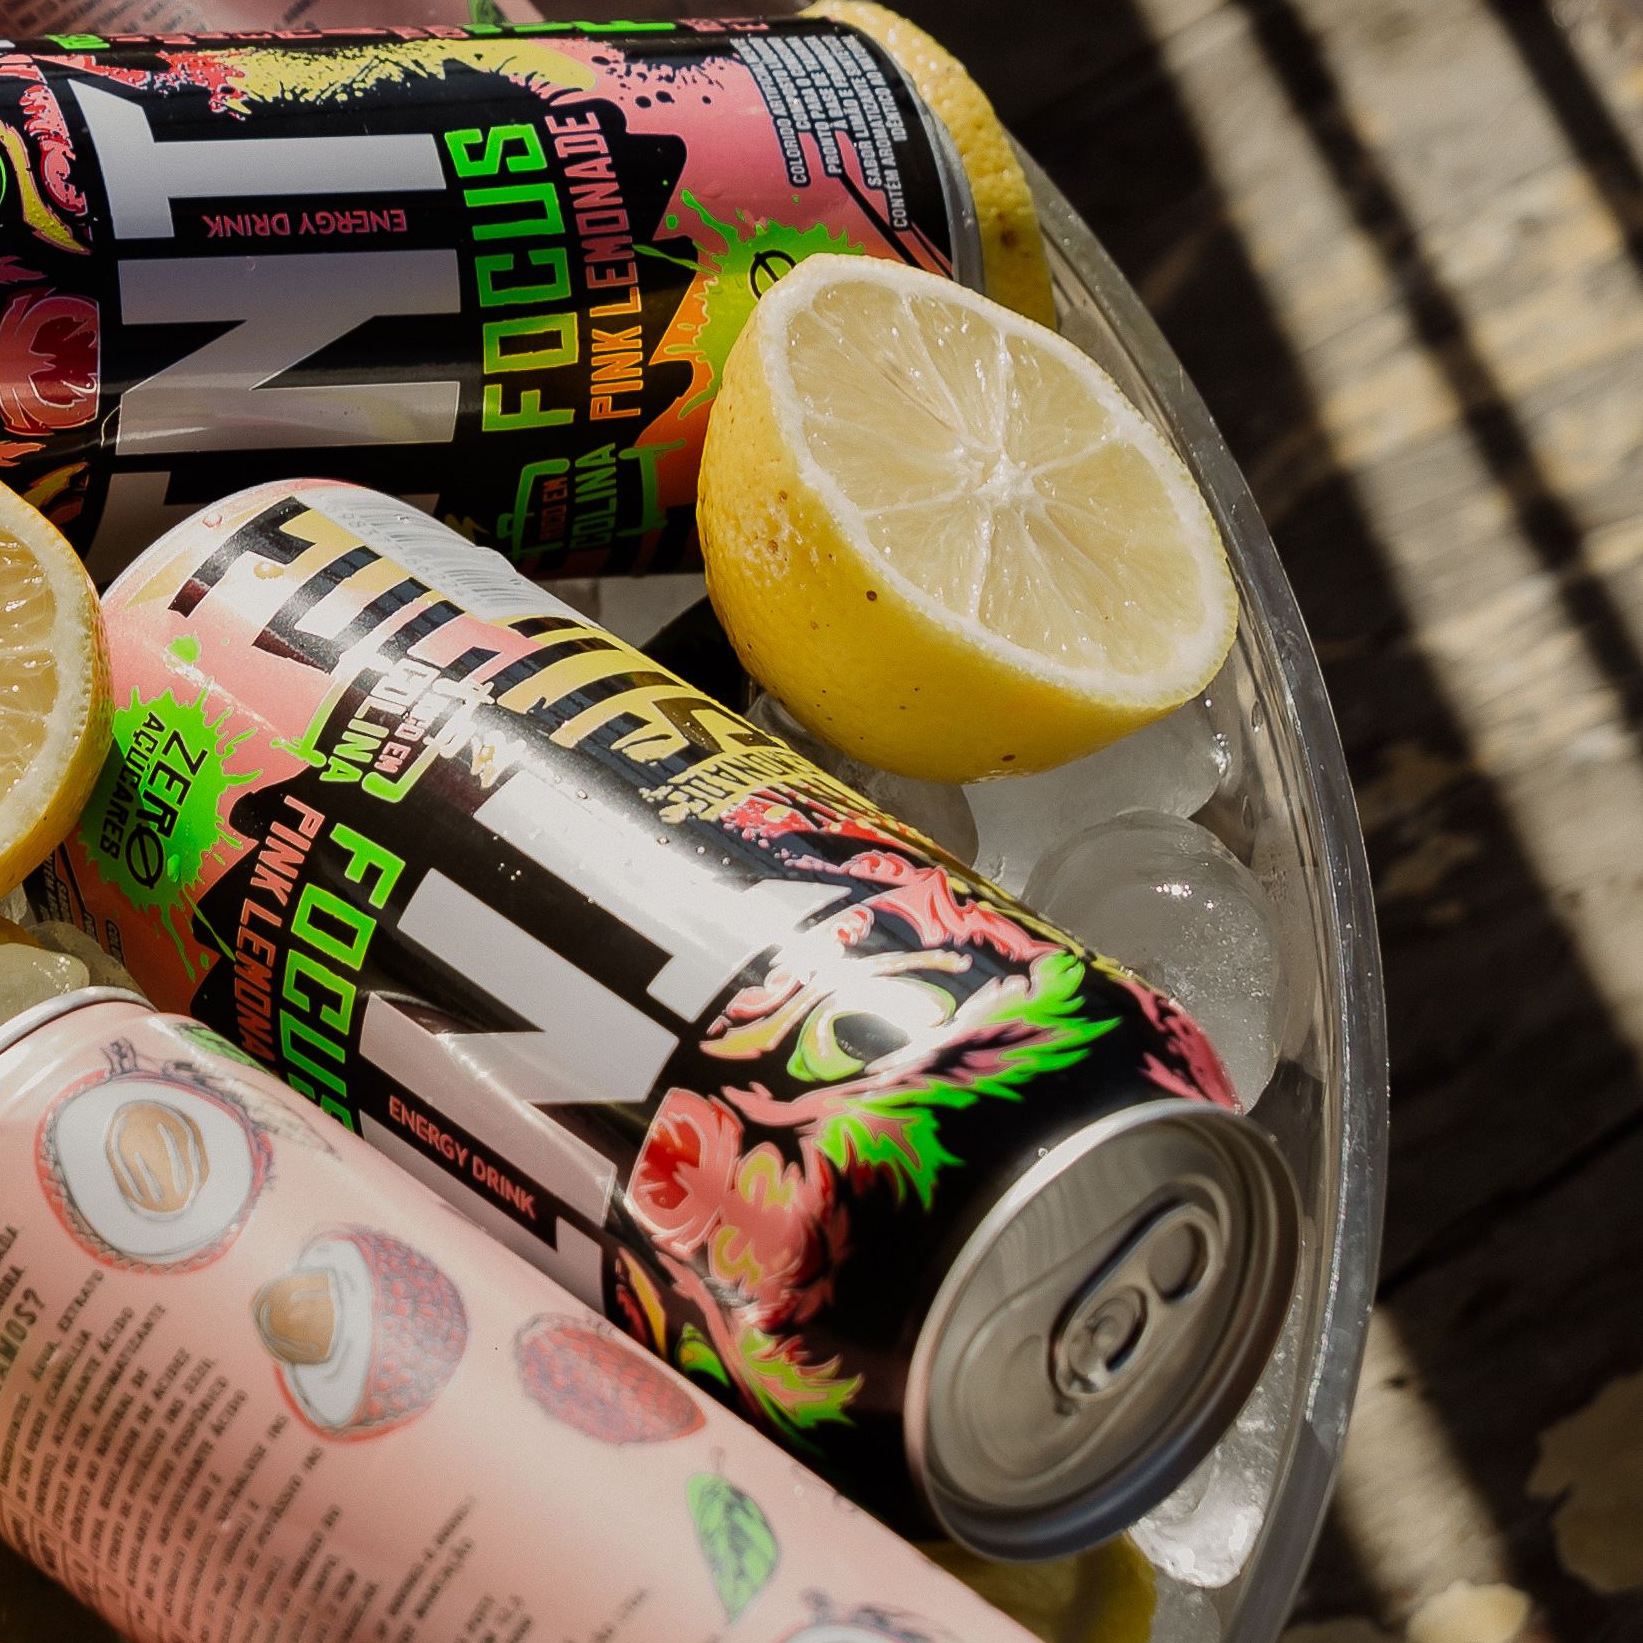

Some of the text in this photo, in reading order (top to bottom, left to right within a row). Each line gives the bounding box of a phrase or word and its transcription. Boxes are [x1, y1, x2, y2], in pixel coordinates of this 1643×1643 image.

[795, 78, 841, 175] PRONTO PARA O
[838, 88, 854, 98] E
[875, 87, 907, 141] IDÊNTICO
[777, 118, 807, 184] COLORIDO
[850, 76, 907, 228] CONTÉM AROMATIZANTE
[858, 140, 882, 187] SABOR
[202, 209, 408, 237] ENERGY DRINK
[564, 113, 646, 422] PINK LEMONADE
[442, 122, 580, 434] FOCUS
[569, 443, 617, 552] COLINA
[321, 663, 424, 784] COLINA
[372, 738, 411, 777] EM
[100, 710, 164, 860] AÇÚCARES
[231, 794, 326, 1064] PINK LEMONA
[388, 1095, 539, 1222] ENERGY DRINK
